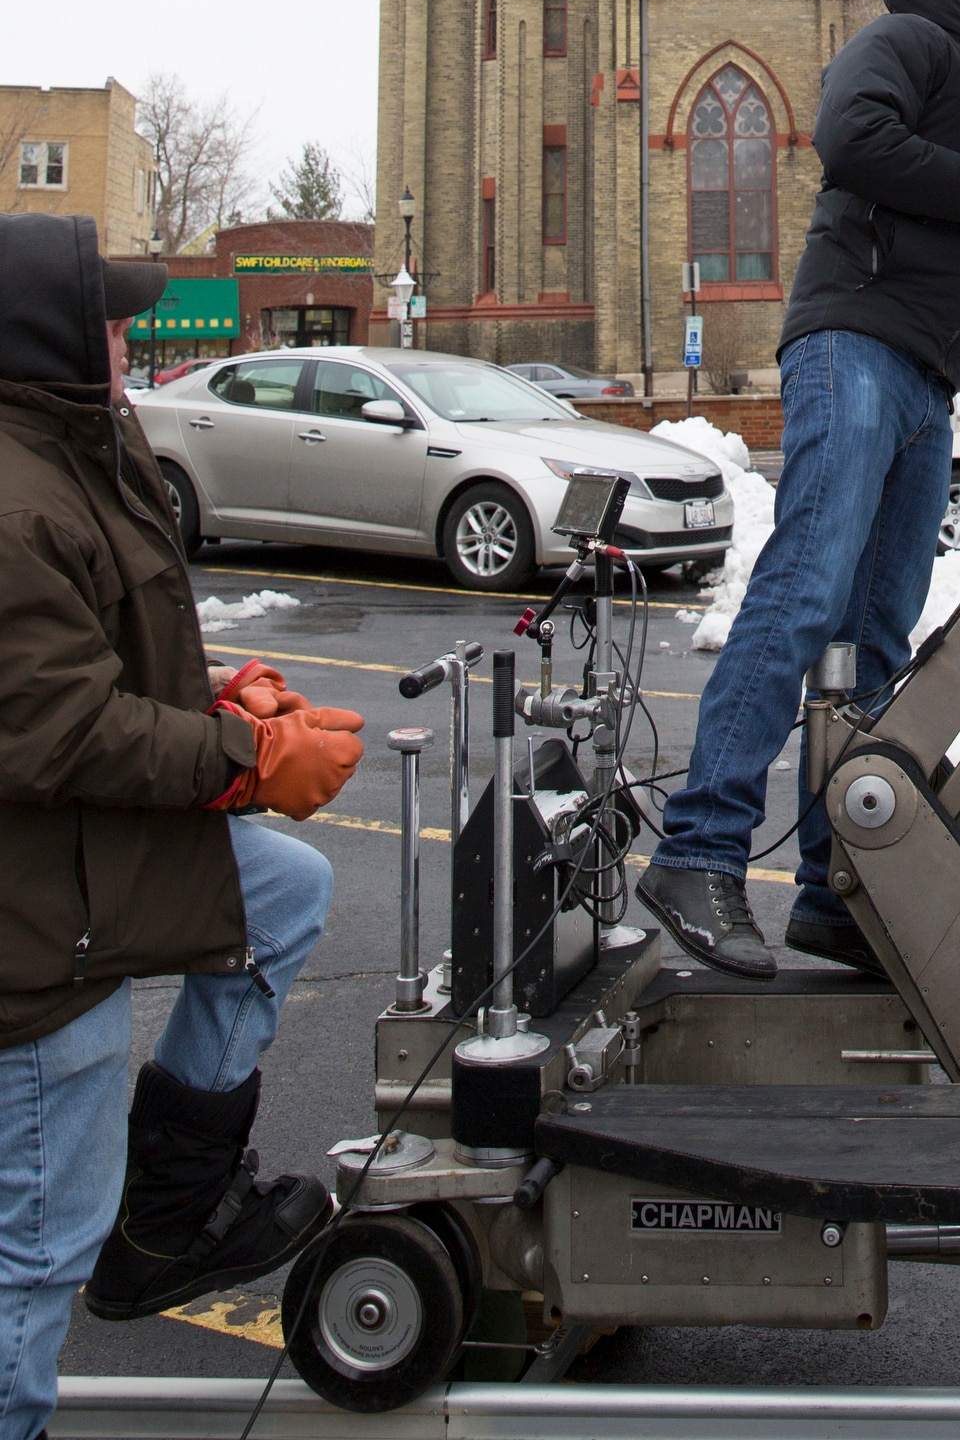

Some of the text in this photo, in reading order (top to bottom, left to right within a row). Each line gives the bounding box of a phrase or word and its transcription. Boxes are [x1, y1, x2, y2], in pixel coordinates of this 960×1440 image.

[236, 257, 264, 267] SWIFT
[264, 257, 290, 267] CHILD
[290, 257, 313, 267] CARE
[640, 1203, 772, 1229] CHAPMAN
[360, 1344, 384, 1352] CAUTION
